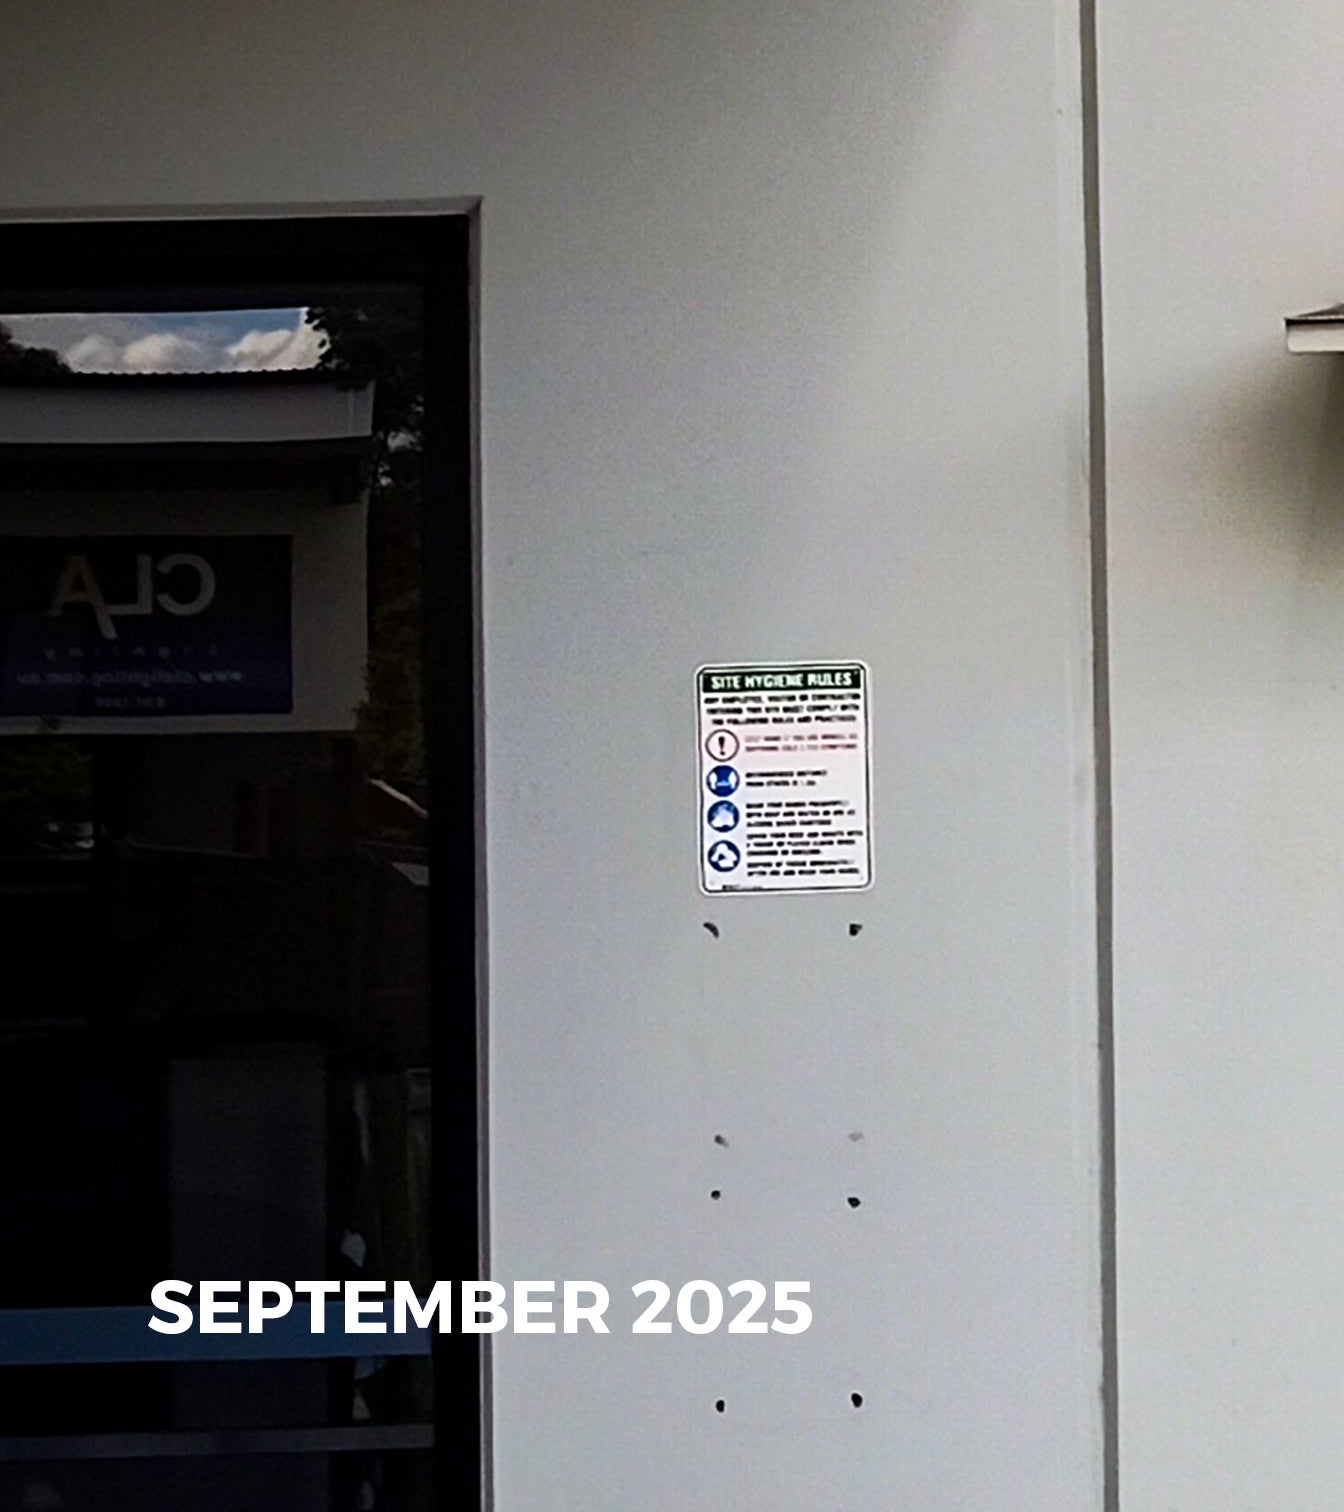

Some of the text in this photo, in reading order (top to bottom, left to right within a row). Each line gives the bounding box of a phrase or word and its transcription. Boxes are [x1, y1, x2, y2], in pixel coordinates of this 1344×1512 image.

[711, 671, 852, 690] SITE HYGIENE RULES
